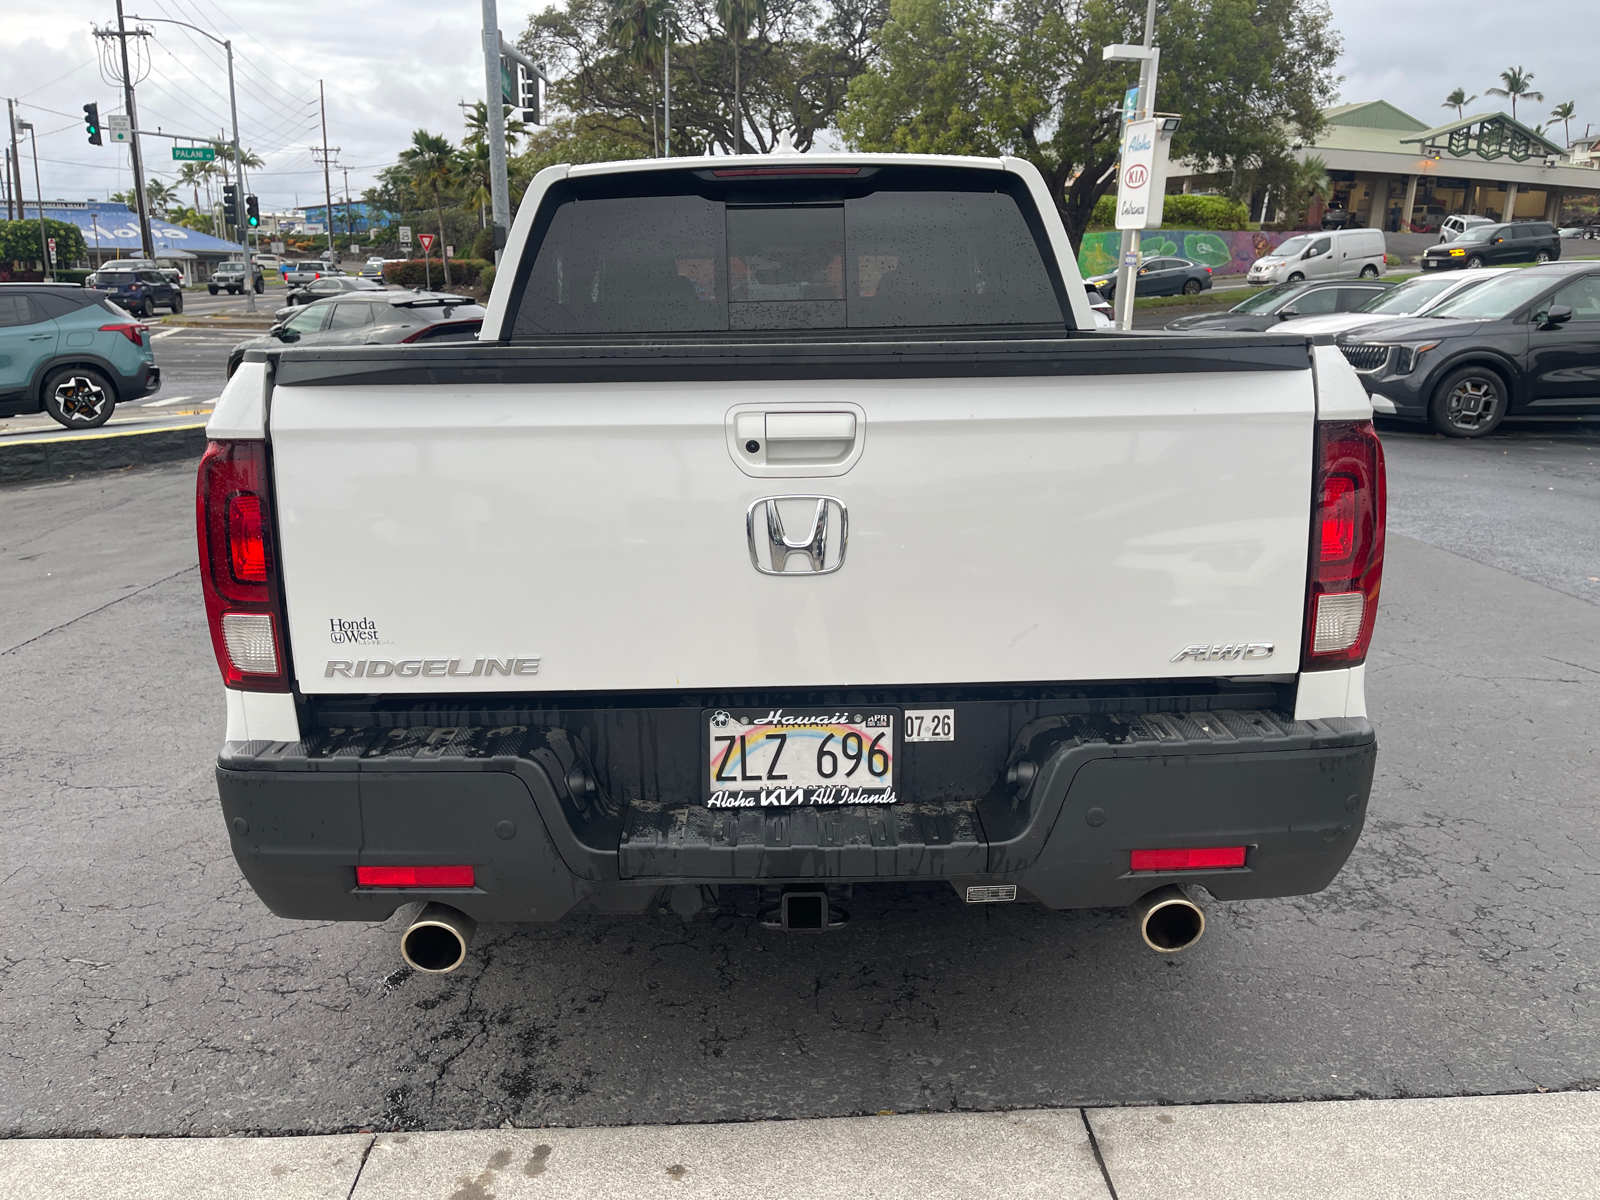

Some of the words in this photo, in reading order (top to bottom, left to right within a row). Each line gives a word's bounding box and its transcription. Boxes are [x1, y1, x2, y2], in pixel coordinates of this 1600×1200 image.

[1128, 133, 1151, 152] Aloha
[175, 150, 203, 158] PALANI
[1129, 170, 1144, 183] KIA
[329, 616, 376, 632] Honda
[343, 630, 379, 643] West
[1169, 642, 1276, 662] AWD
[324, 656, 542, 678] RIDGELINE
[753, 709, 849, 725] Hawaii
[905, 715, 925, 738] 07
[931, 715, 951, 736] 26
[714, 733, 788, 782] ZLZ
[817, 731, 889, 779] 696
[707, 790, 756, 808] Aloha
[810, 787, 836, 805] All
[837, 786, 897, 805] Islands
